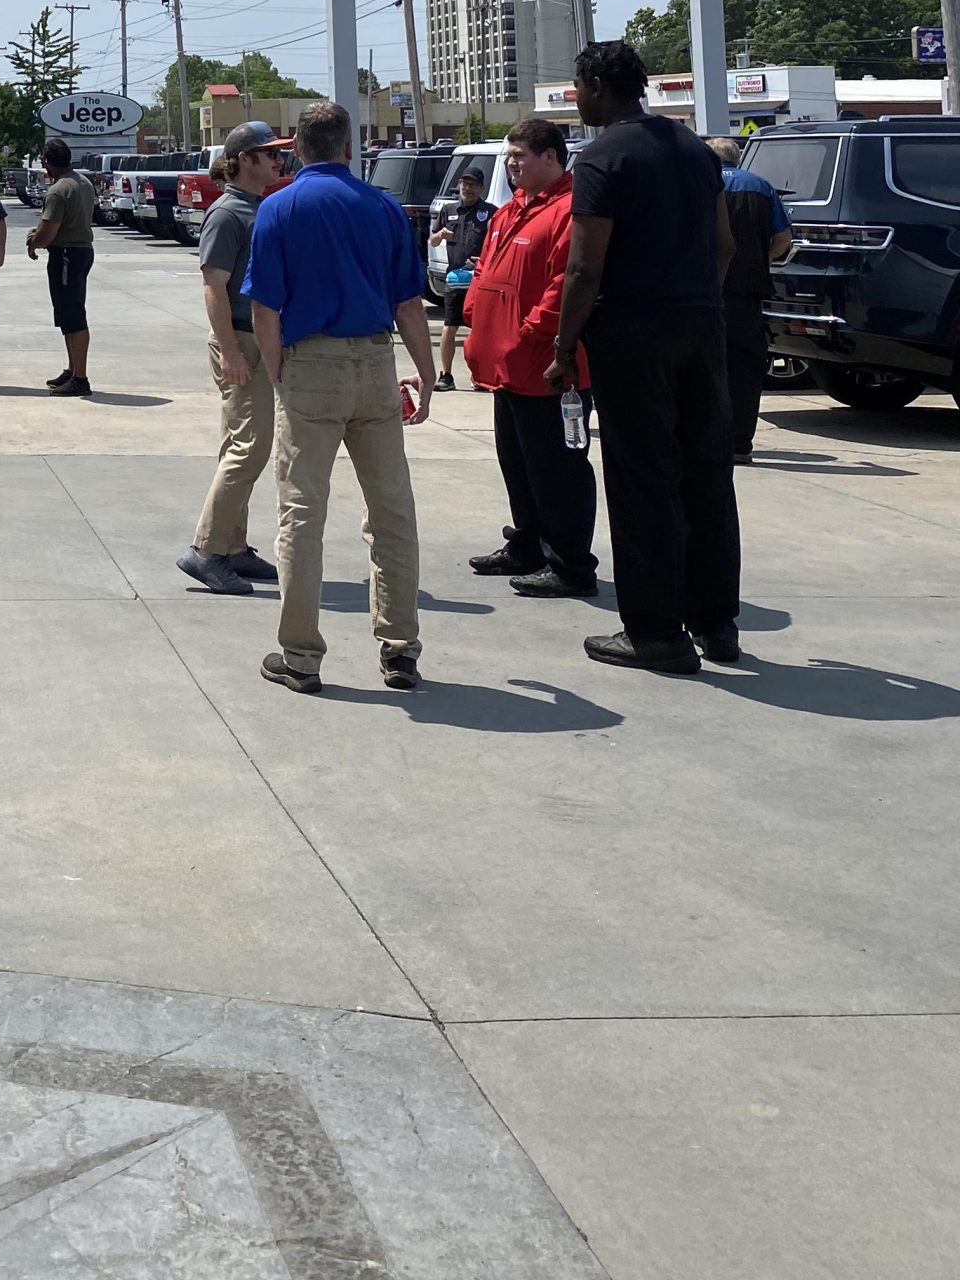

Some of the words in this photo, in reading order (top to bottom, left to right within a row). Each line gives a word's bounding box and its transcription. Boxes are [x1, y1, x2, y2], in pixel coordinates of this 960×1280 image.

[82, 96, 101, 105] The
[61, 102, 122, 127] Jeep
[79, 124, 105, 133] Store
